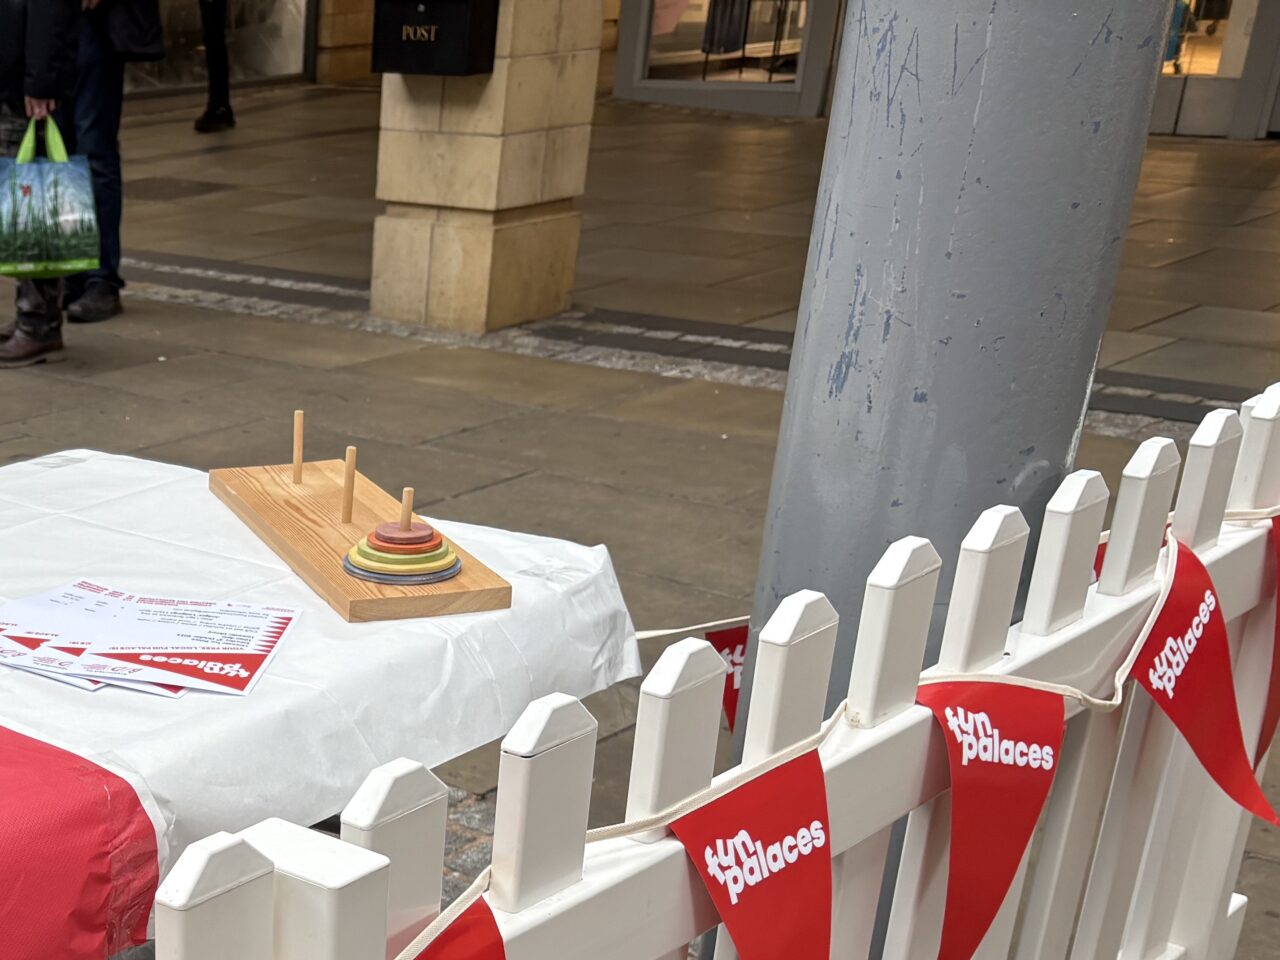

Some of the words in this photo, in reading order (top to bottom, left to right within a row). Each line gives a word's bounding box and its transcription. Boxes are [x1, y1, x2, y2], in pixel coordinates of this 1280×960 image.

[402, 24, 438, 41] POST
[139, 655, 242, 674] palaces
[1149, 636, 1179, 691] fun
[1162, 589, 1217, 700] palaces
[946, 706, 993, 744] fun
[961, 730, 1054, 771] palaces
[704, 829, 756, 887] fun
[724, 820, 826, 905] palaces
